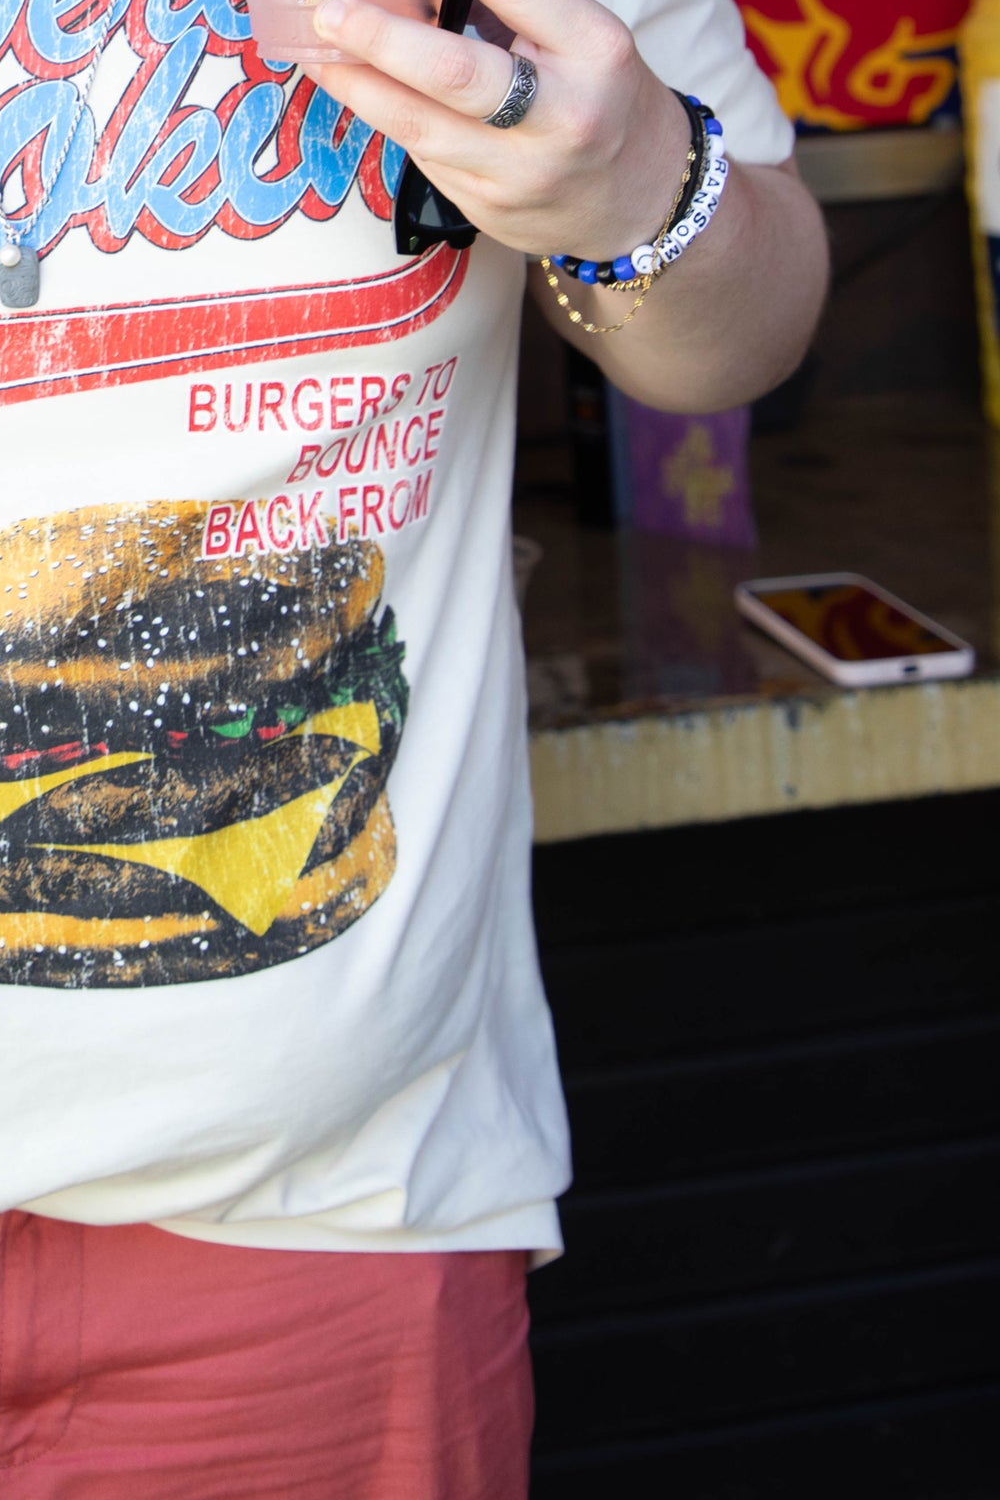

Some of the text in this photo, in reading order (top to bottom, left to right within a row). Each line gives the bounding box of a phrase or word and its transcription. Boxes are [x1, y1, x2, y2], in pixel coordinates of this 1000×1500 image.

[659, 157, 727, 263] RANSOM
[188, 355, 459, 433] BURGERS TO
[286, 409, 445, 484] BOUNCE
[204, 468, 433, 557] BACK FROM
